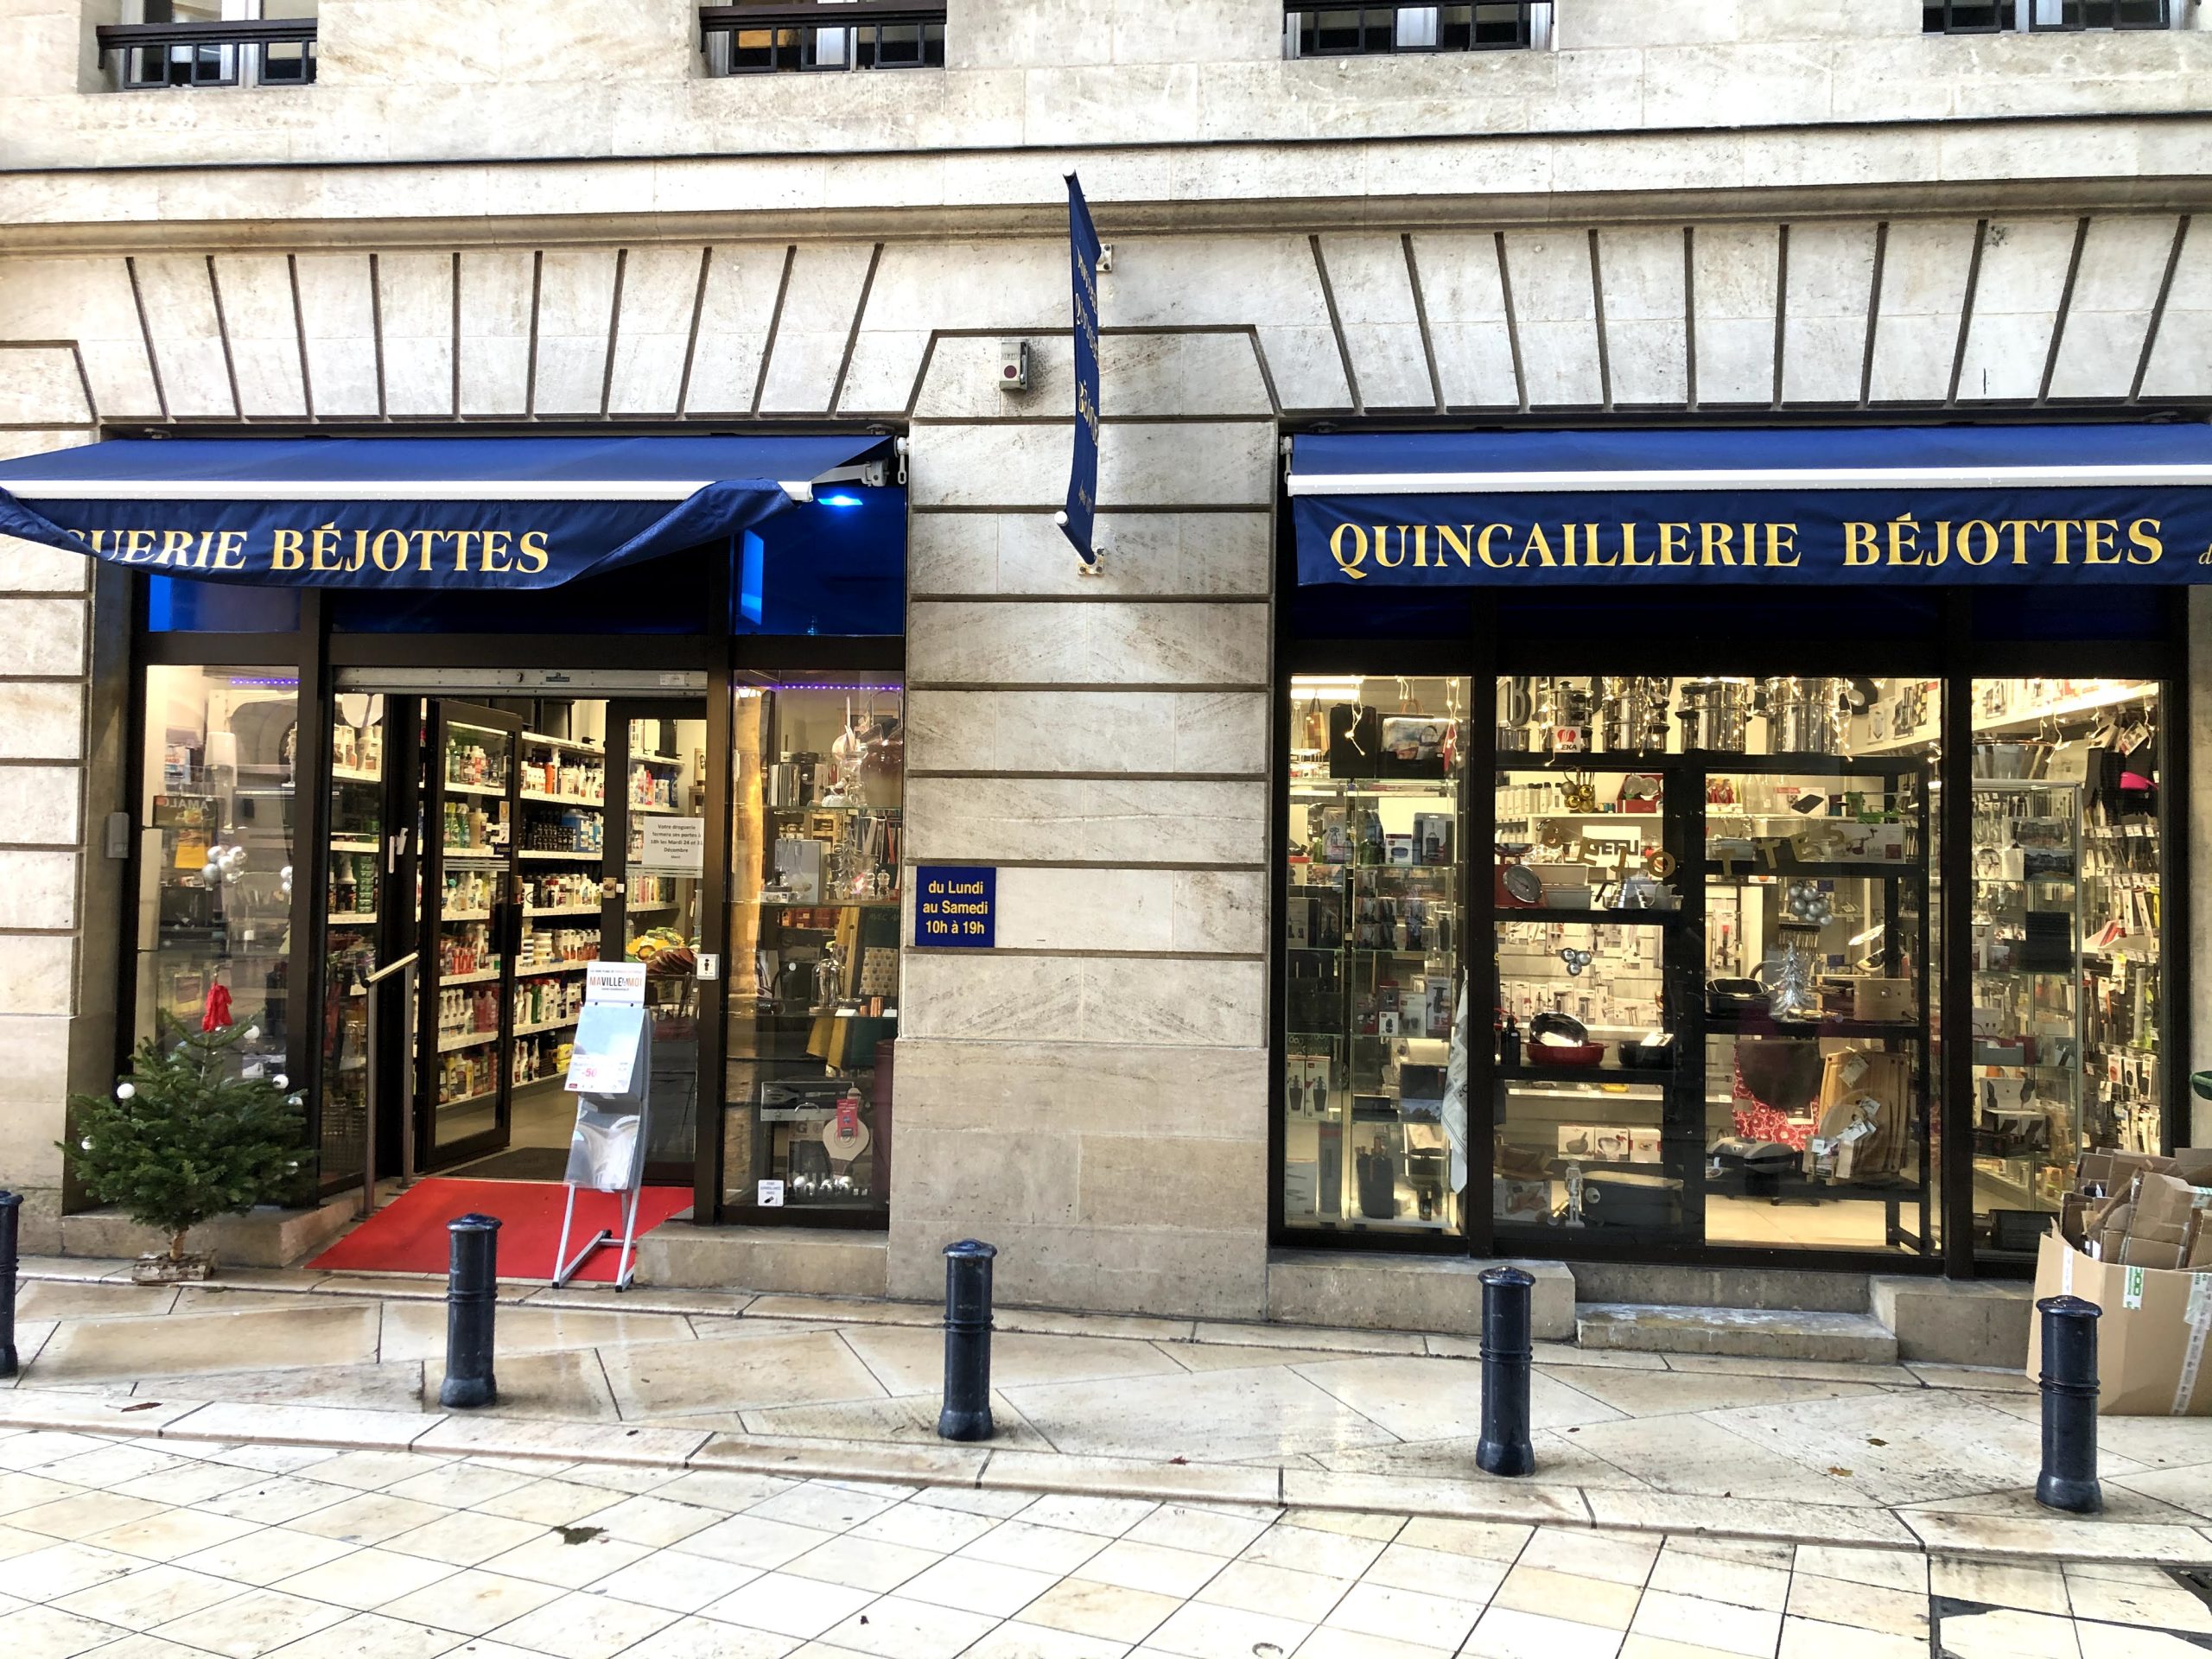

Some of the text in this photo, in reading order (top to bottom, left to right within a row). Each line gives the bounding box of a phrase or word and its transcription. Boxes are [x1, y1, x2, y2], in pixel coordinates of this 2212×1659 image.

[270, 522, 549, 574] BÉJOTTES
[1329, 522, 1802, 580] QUINCAILLERIE
[1842, 512, 2163, 567] BÉJOTTES
[928, 880, 983, 894] du Lundi
[922, 899, 988, 914] au Samedi
[925, 920, 985, 934] 10h à 19h
